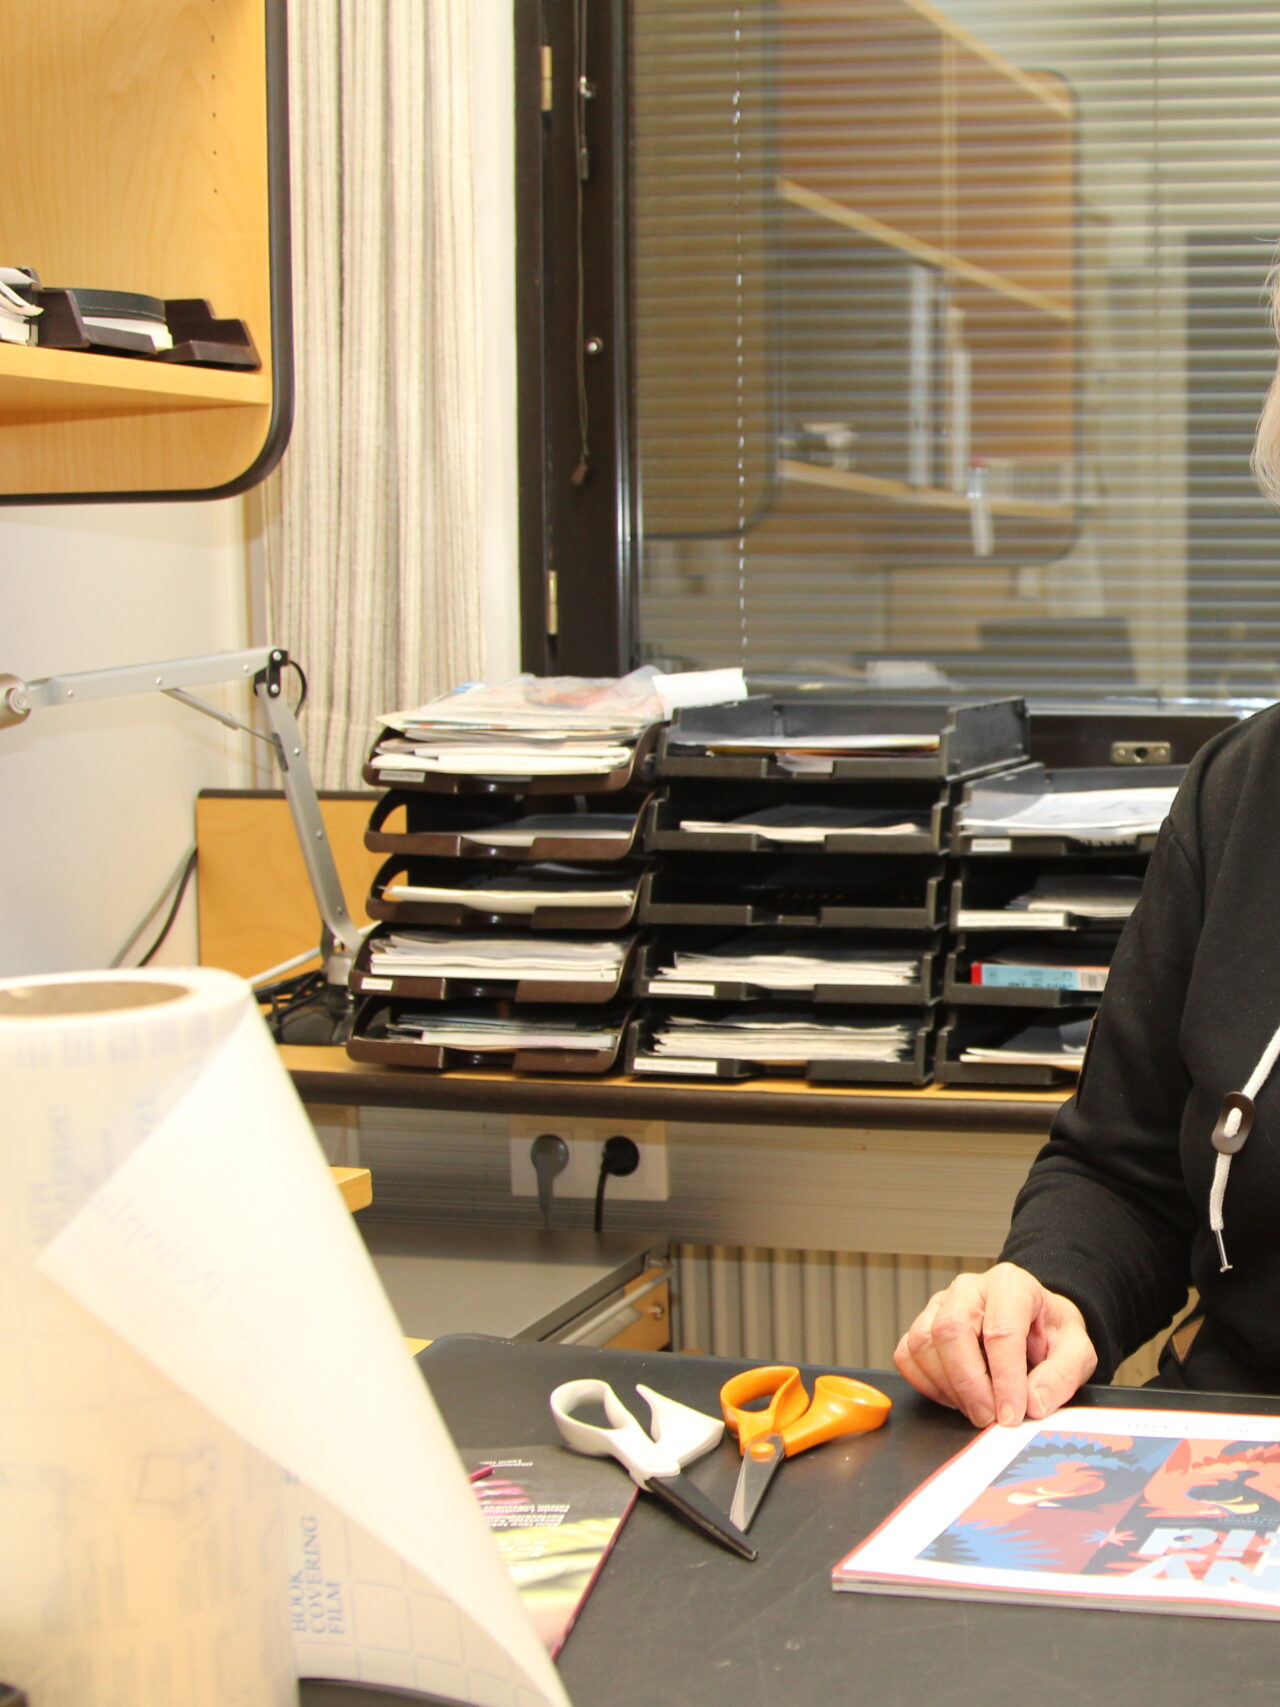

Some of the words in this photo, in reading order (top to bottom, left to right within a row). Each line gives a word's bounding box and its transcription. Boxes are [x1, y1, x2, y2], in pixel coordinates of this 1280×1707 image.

[287, 1569, 308, 1632] BOOK
[300, 1515, 327, 1635] COVERING
[323, 1580, 346, 1636] FILM
